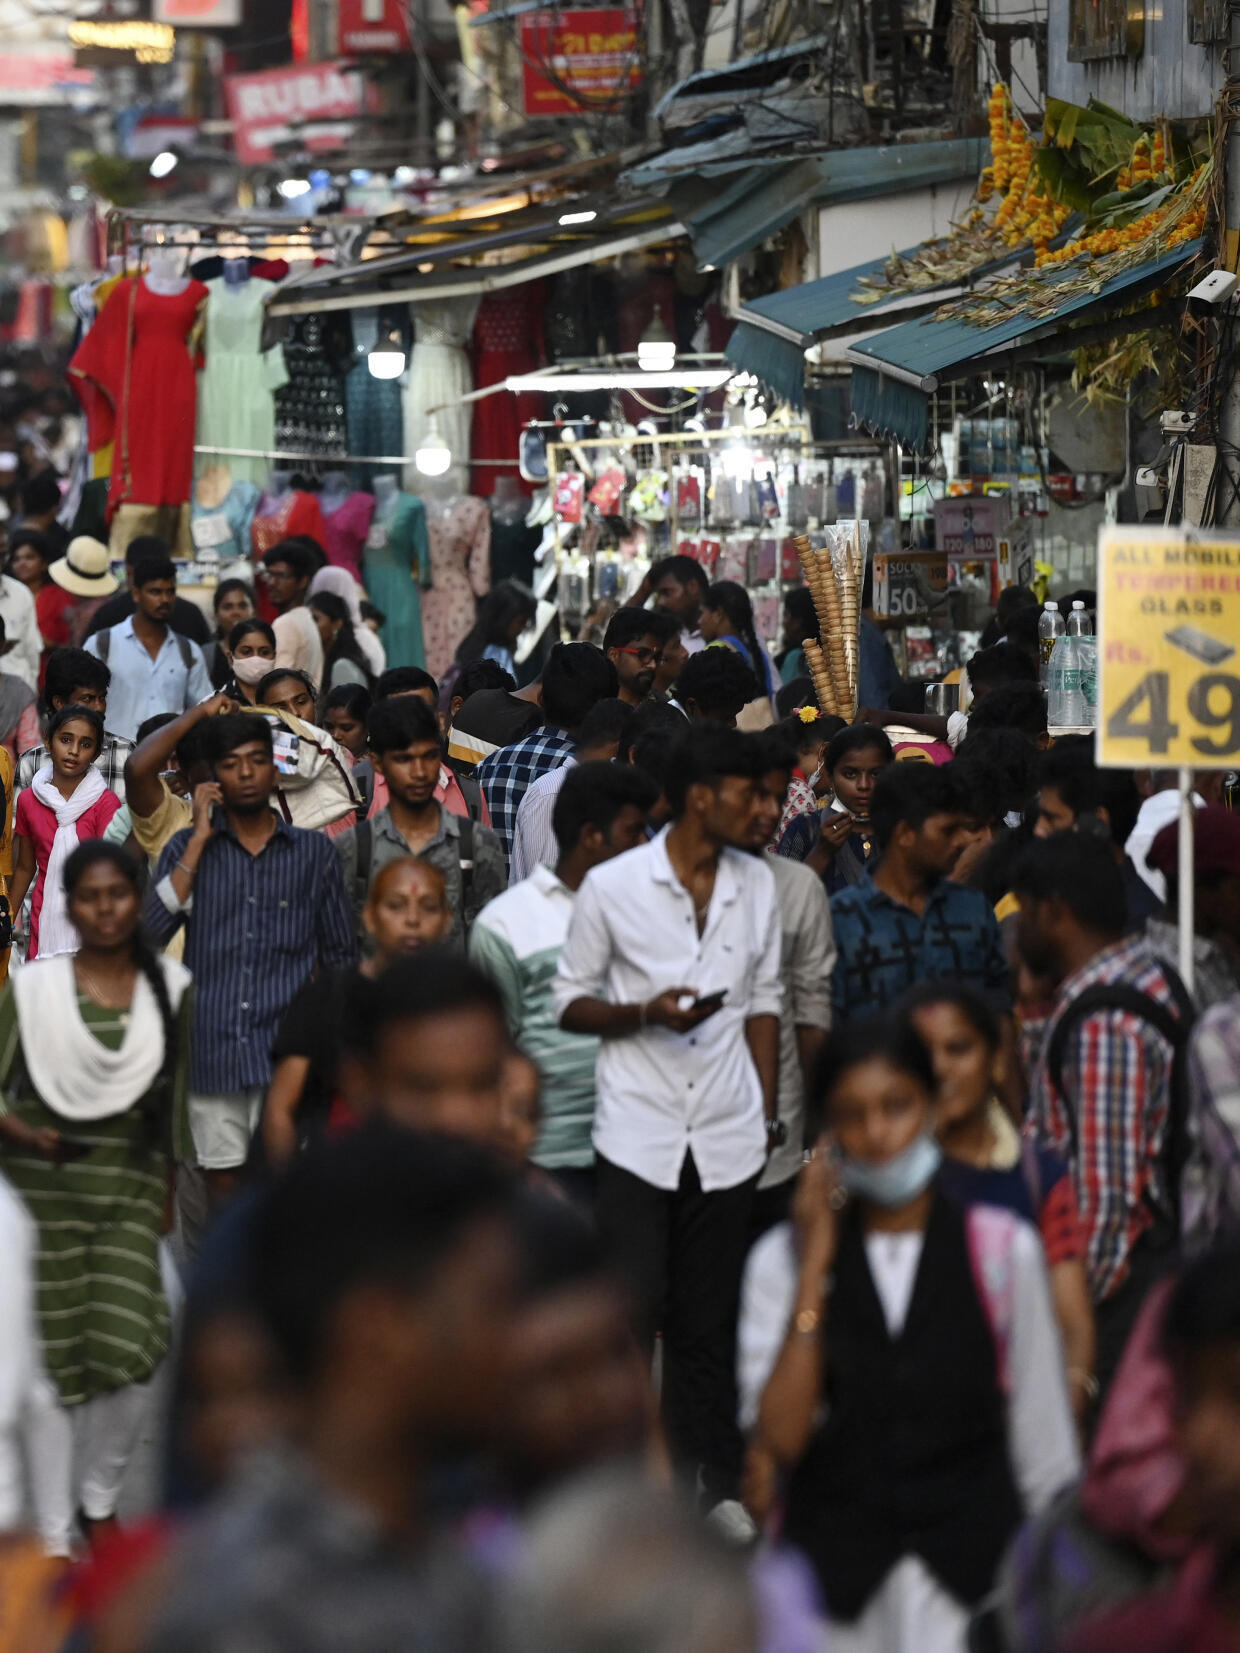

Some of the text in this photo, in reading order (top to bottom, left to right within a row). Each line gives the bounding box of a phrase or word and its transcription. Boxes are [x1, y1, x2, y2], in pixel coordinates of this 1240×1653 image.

[1114, 550, 1152, 564] ALL
[891, 587, 917, 614] 50
[1141, 598, 1223, 615] GLASS
[1107, 670, 1240, 757] 49
